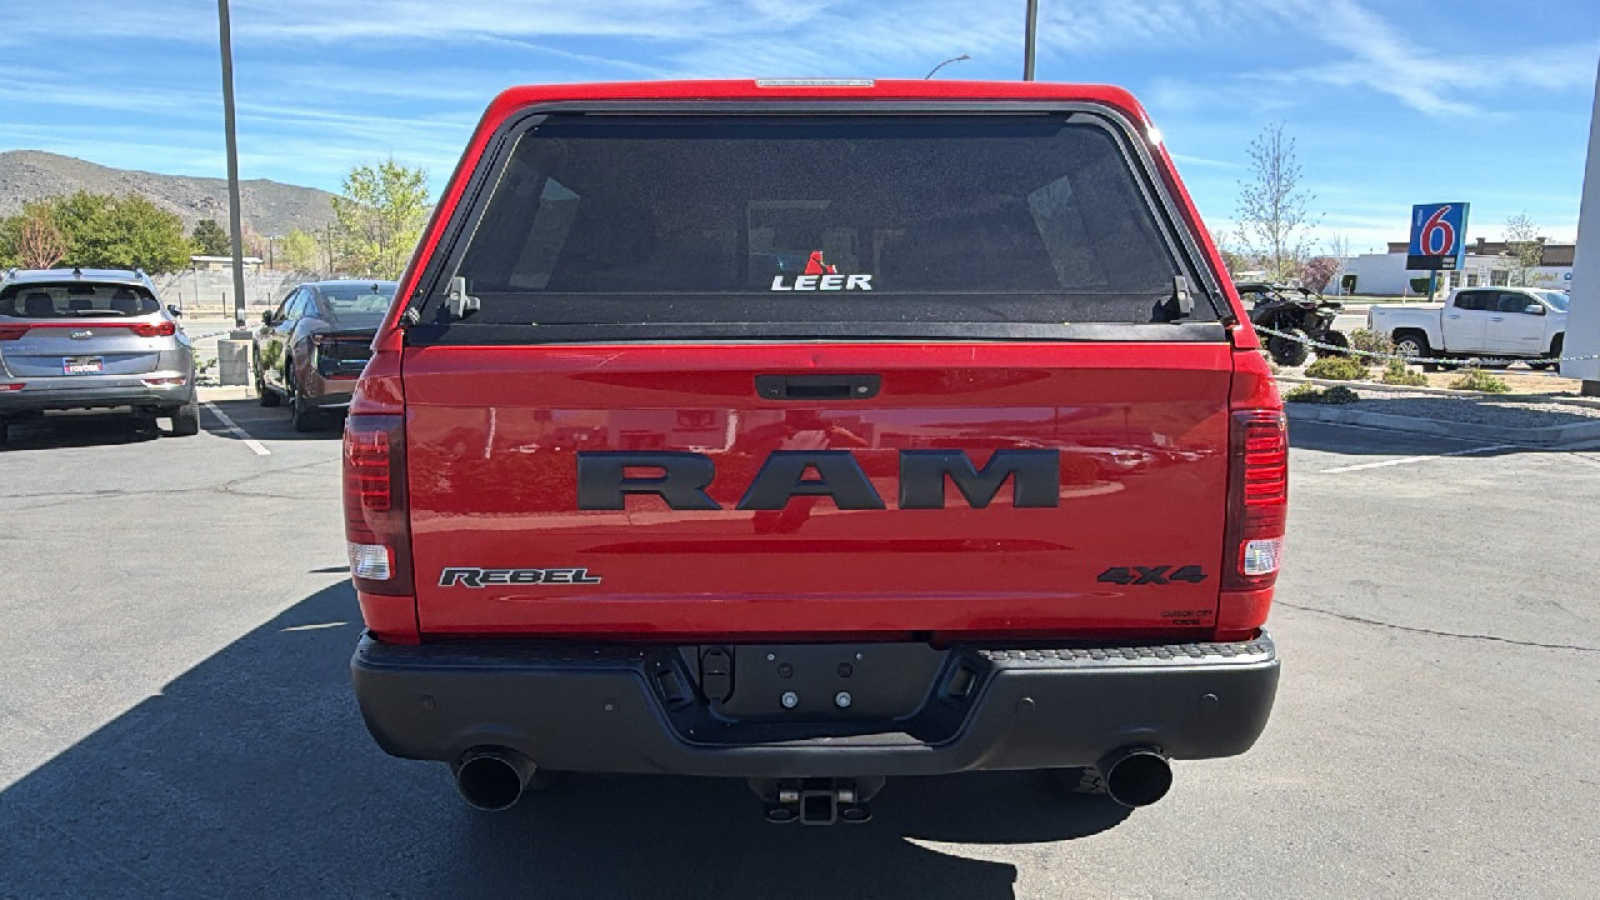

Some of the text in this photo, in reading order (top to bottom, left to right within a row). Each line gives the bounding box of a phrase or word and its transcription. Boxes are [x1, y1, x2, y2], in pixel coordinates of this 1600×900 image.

[1420, 205, 1455, 255] 6
[770, 274, 873, 291] LEER
[577, 449, 1060, 510] RAM
[438, 566, 602, 588] REBEL
